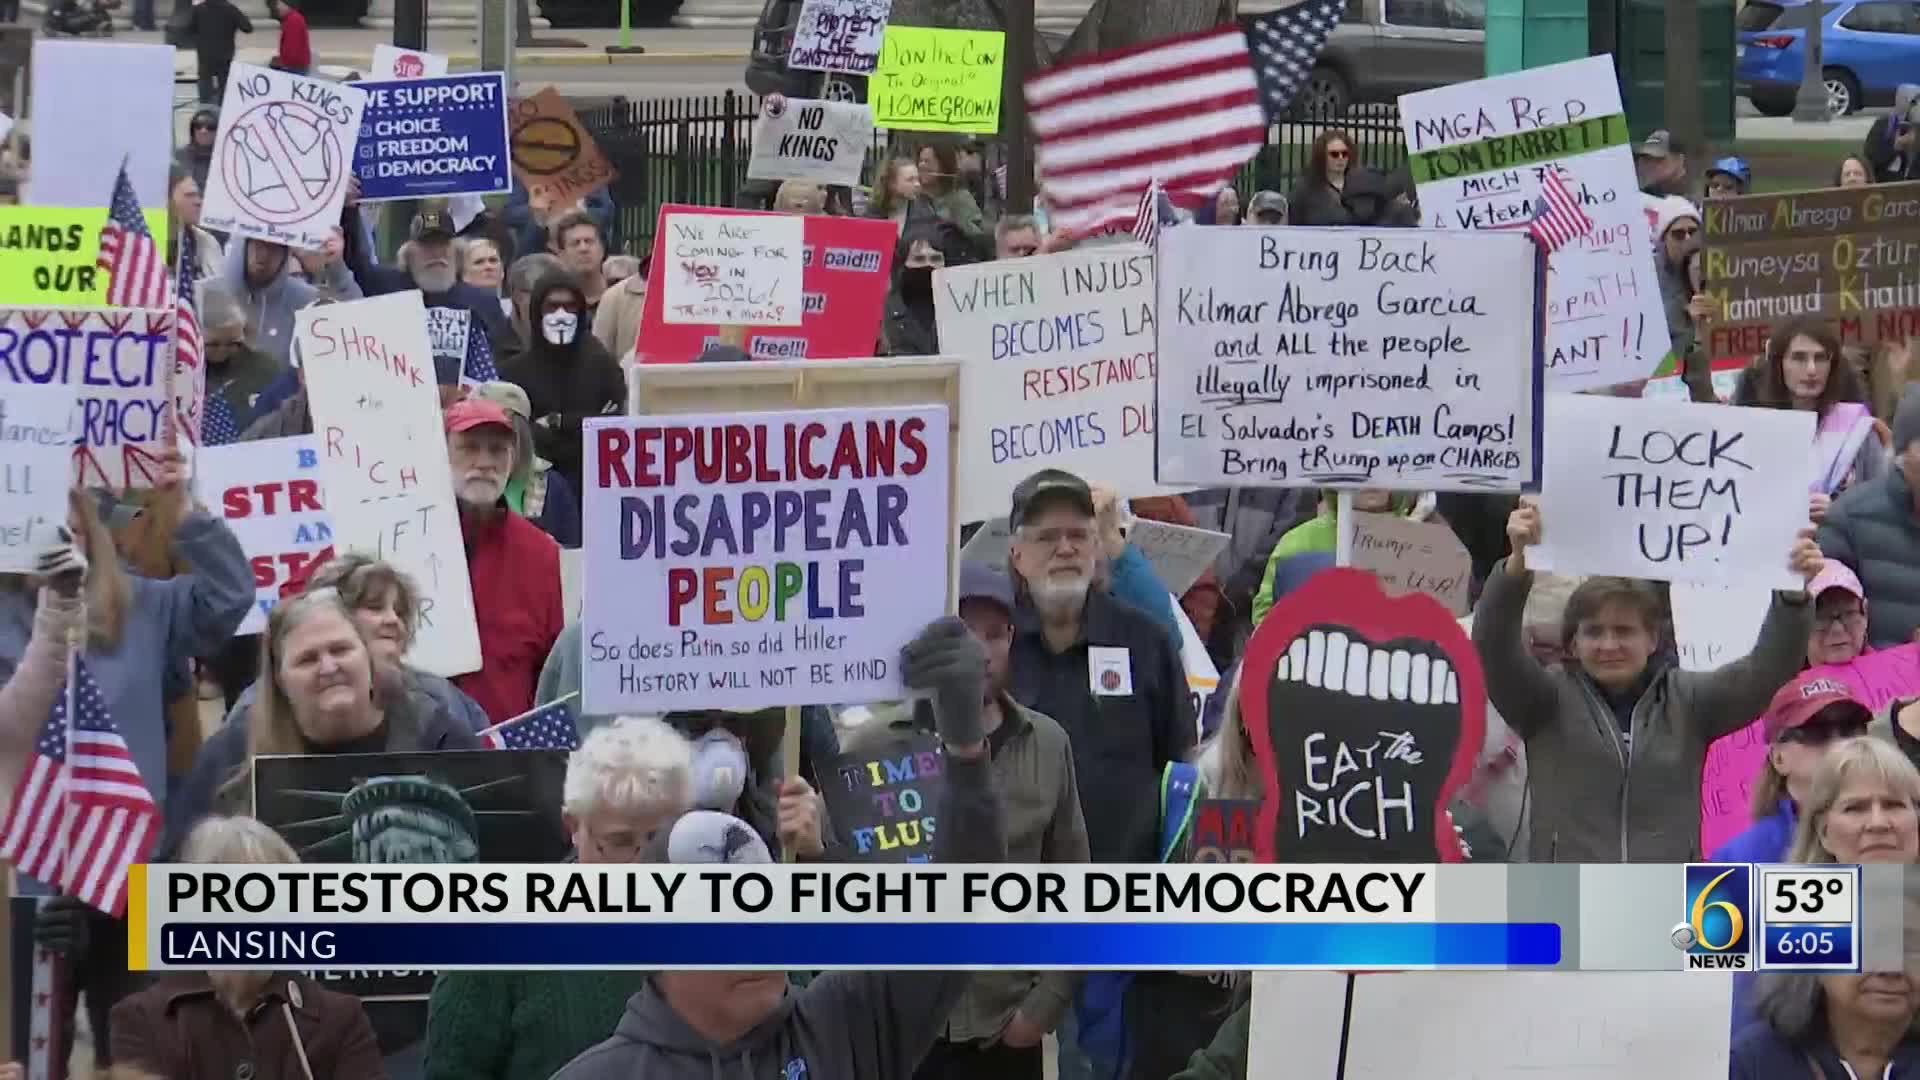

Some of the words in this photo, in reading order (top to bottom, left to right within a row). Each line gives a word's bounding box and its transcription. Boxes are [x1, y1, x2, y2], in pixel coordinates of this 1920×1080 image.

[394, 62, 423, 75] STOP
[237, 74, 271, 102] NO
[291, 80, 354, 126] KINGS
[394, 82, 497, 107] SUPPORT
[876, 93, 997, 124] HOMEGROWN
[375, 117, 442, 136] CHOICE
[798, 107, 824, 131] NO
[1415, 107, 1496, 151] MAGA
[1506, 96, 1586, 129] REP
[377, 135, 469, 158] FREEDOM
[778, 135, 839, 162] KINGS
[1421, 136, 1486, 181] TOM
[1490, 117, 1611, 170] BARRETT
[378, 155, 496, 178] DEMOCRACY
[1463, 170, 1520, 197] MICH
[674, 223, 705, 240] WE
[718, 222, 756, 239] ARE
[1705, 206, 1766, 233] Kilmar
[1771, 198, 1852, 232] Abrego
[1863, 193, 1920, 222] Garc
[4, 224, 84, 251] ANDS
[675, 244, 745, 257] COMING
[752, 245, 789, 259] FOR
[729, 267, 745, 278] IN
[823, 246, 880, 271] paid!!!
[1259, 235, 1339, 281] Bring
[1358, 237, 1437, 274] Back
[1706, 247, 1820, 285] Rumeysa
[33, 265, 97, 291] OUR
[947, 271, 1036, 313] WHEN
[1178, 286, 1268, 326] Kilmar
[1277, 281, 1359, 328] Abrego
[1377, 281, 1486, 317] Garcia
[753, 338, 807, 357] free!!!
[992, 311, 1105, 360] BECOMES
[1122, 303, 1156, 336] LA
[1214, 333, 1260, 360] and
[1276, 333, 1317, 357] ALL
[1328, 331, 1369, 358] the
[1382, 325, 1471, 360] people
[310, 317, 425, 388] SHRINK
[1546, 334, 1608, 369] ANT
[1024, 351, 1157, 401] RESISTANCE
[1195, 363, 1291, 400] illegally
[1306, 363, 1433, 400] imprisoned
[1455, 367, 1481, 391] in
[75, 398, 168, 446] RACY
[991, 411, 1106, 464] BECOMES
[1221, 413, 1335, 442] Salvador's
[1352, 411, 1421, 440] DEATH
[1433, 403, 1515, 447] Camps!
[327, 426, 418, 489] RICH
[597, 416, 929, 489] REPUBLICANS
[1221, 448, 1289, 480] Bring
[1299, 447, 1381, 478] tRump
[1608, 424, 1753, 470] LOCK
[222, 479, 322, 519] STR
[1602, 472, 1741, 514] THEM
[350, 504, 437, 561] IFT
[619, 483, 910, 560] DISAPPEAR
[1638, 513, 1732, 563] UP!
[667, 558, 866, 626] PEOPLE
[590, 631, 621, 661] So
[628, 634, 674, 660] does
[681, 629, 724, 658] Putin
[731, 640, 752, 654] so
[758, 632, 783, 653] did
[795, 624, 848, 651] Hitler
[619, 663, 700, 694] HISTORY
[708, 669, 751, 690] WILL
[760, 666, 798, 687] NOT
[810, 664, 834, 684] BE
[844, 659, 888, 681] KIND
[1304, 732, 1381, 791] EAT
[872, 788, 923, 817] TO
[1295, 776, 1415, 840] RICH
